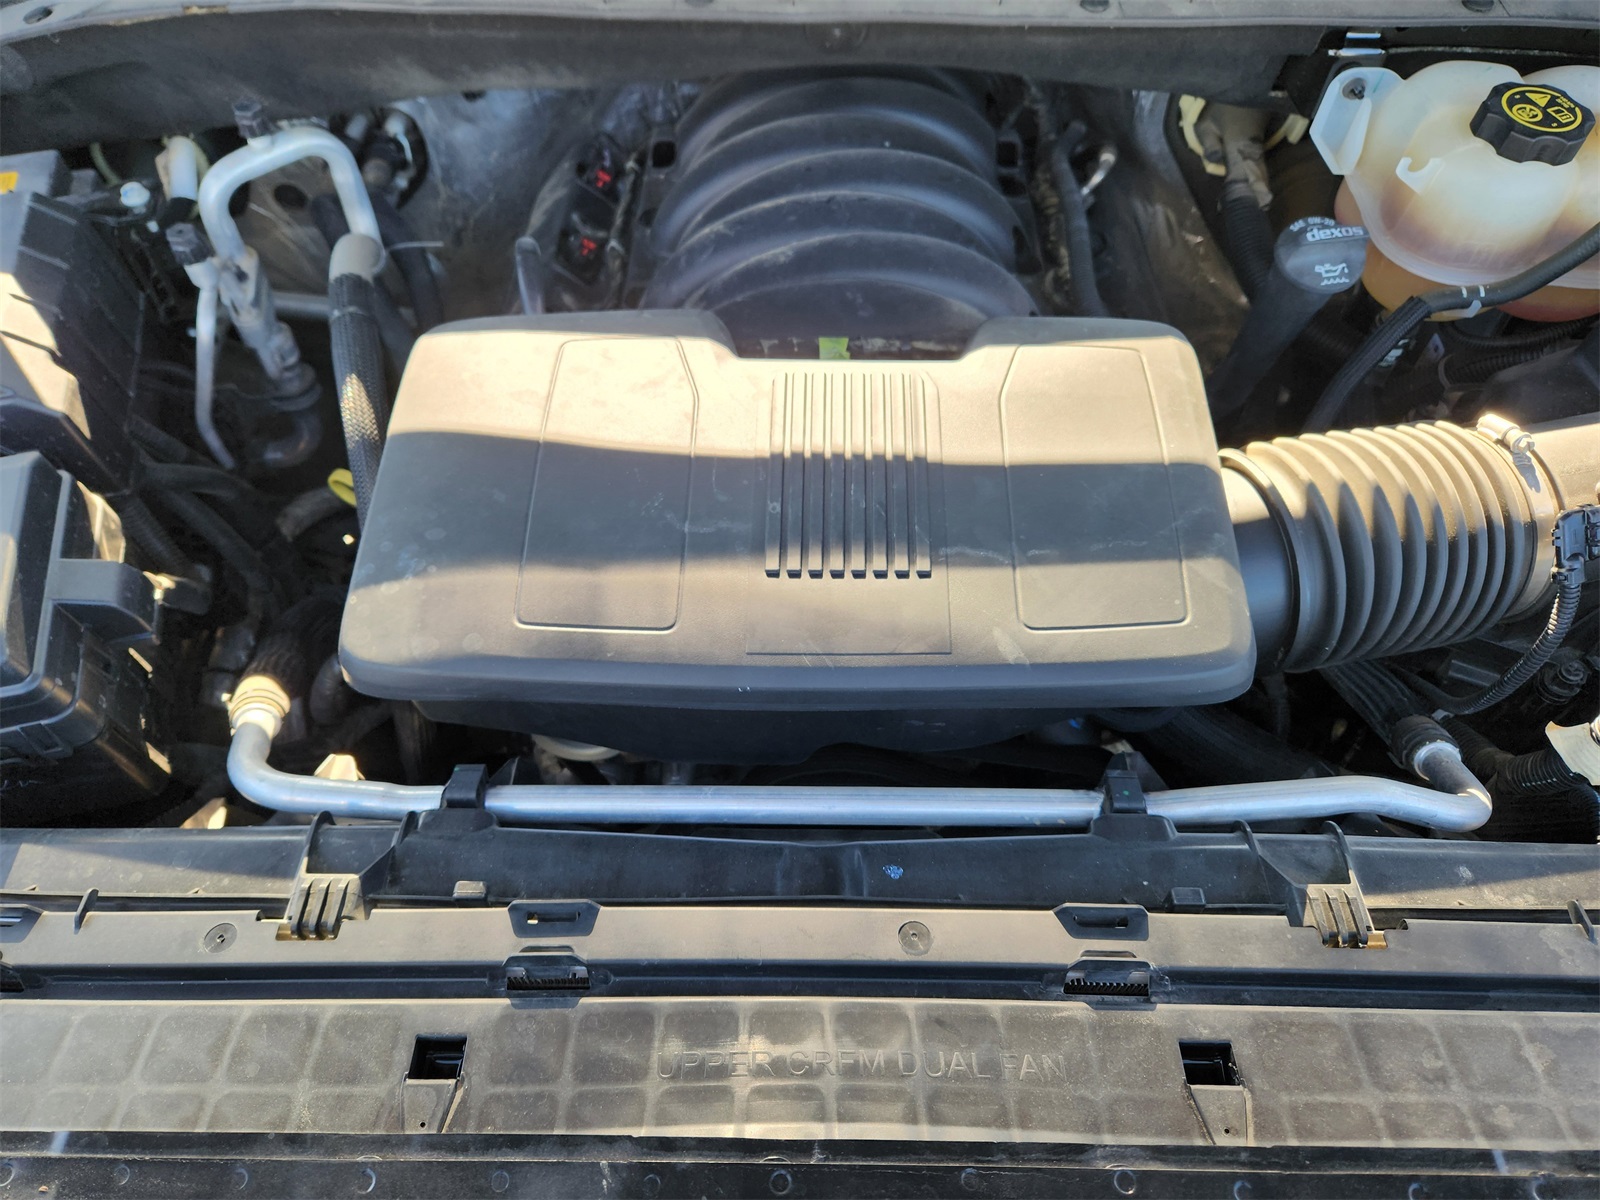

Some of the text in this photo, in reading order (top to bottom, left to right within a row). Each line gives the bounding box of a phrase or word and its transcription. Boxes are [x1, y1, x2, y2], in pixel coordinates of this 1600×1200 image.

[1306, 226, 1364, 242] dexos
[656, 1049, 1068, 1082] UPPER CRFM DUAL FAN
